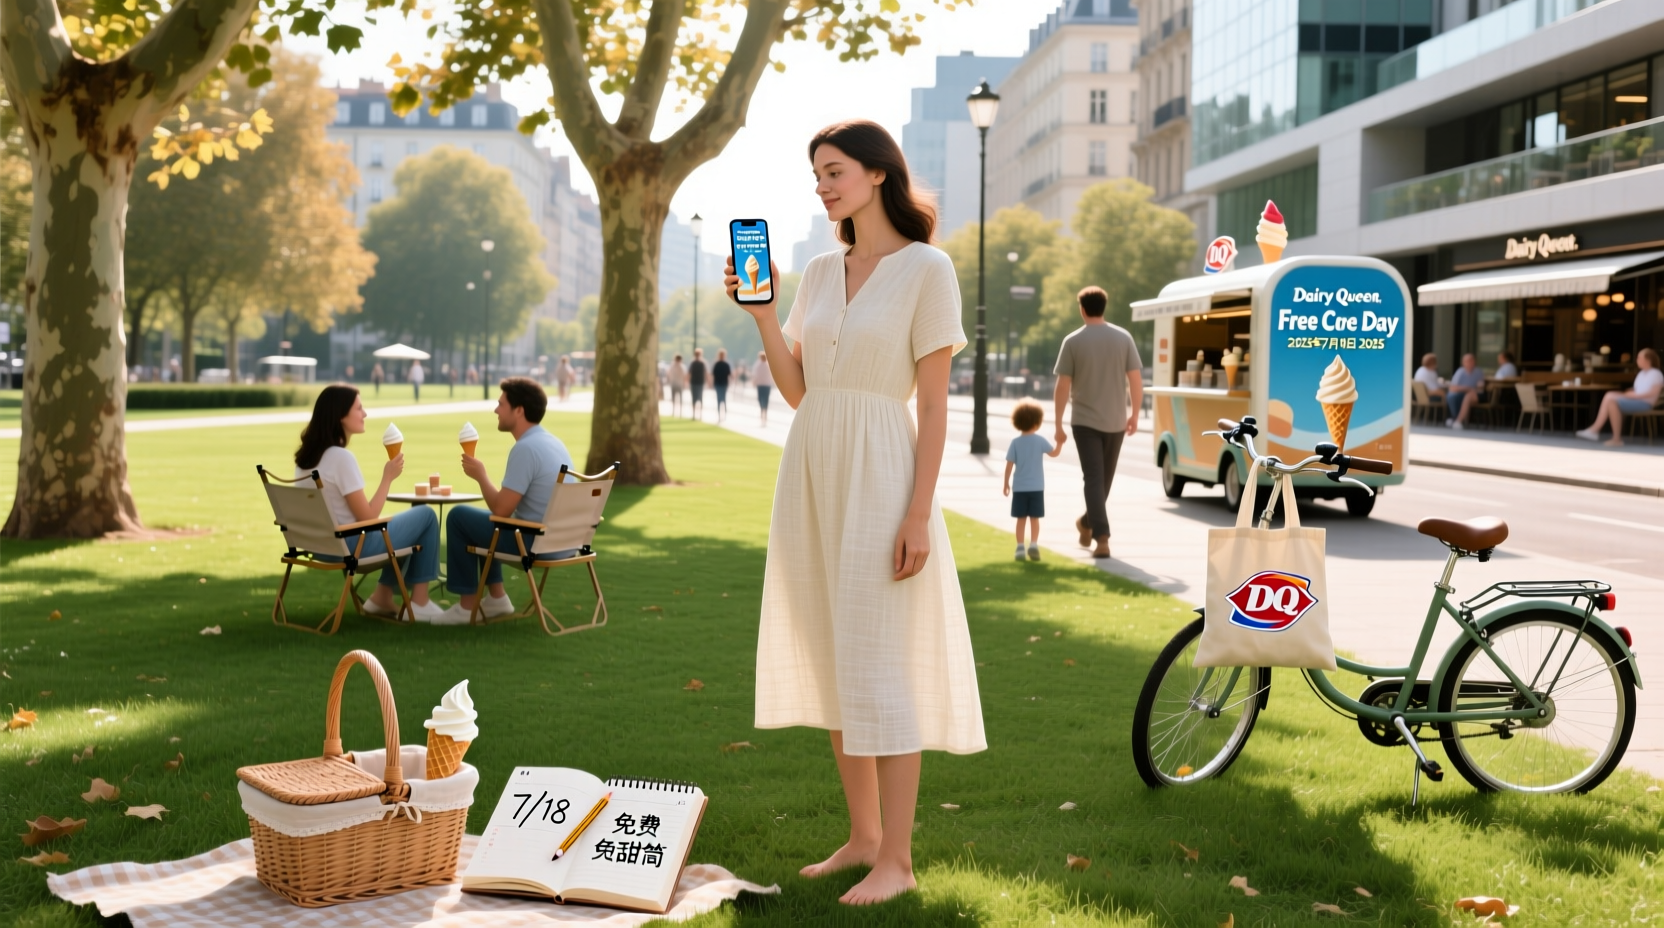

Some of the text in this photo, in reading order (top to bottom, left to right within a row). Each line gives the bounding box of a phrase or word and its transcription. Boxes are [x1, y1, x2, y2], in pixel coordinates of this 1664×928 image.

[1505, 237, 1538, 260] Dairy
[1293, 287, 1334, 306] Dairy
[1278, 309, 1318, 331] Free
[1361, 310, 1399, 338] Day
[1245, 584, 1300, 616] DQ
[512, 790, 571, 828] 7/18
[612, 811, 661, 837] 免费
